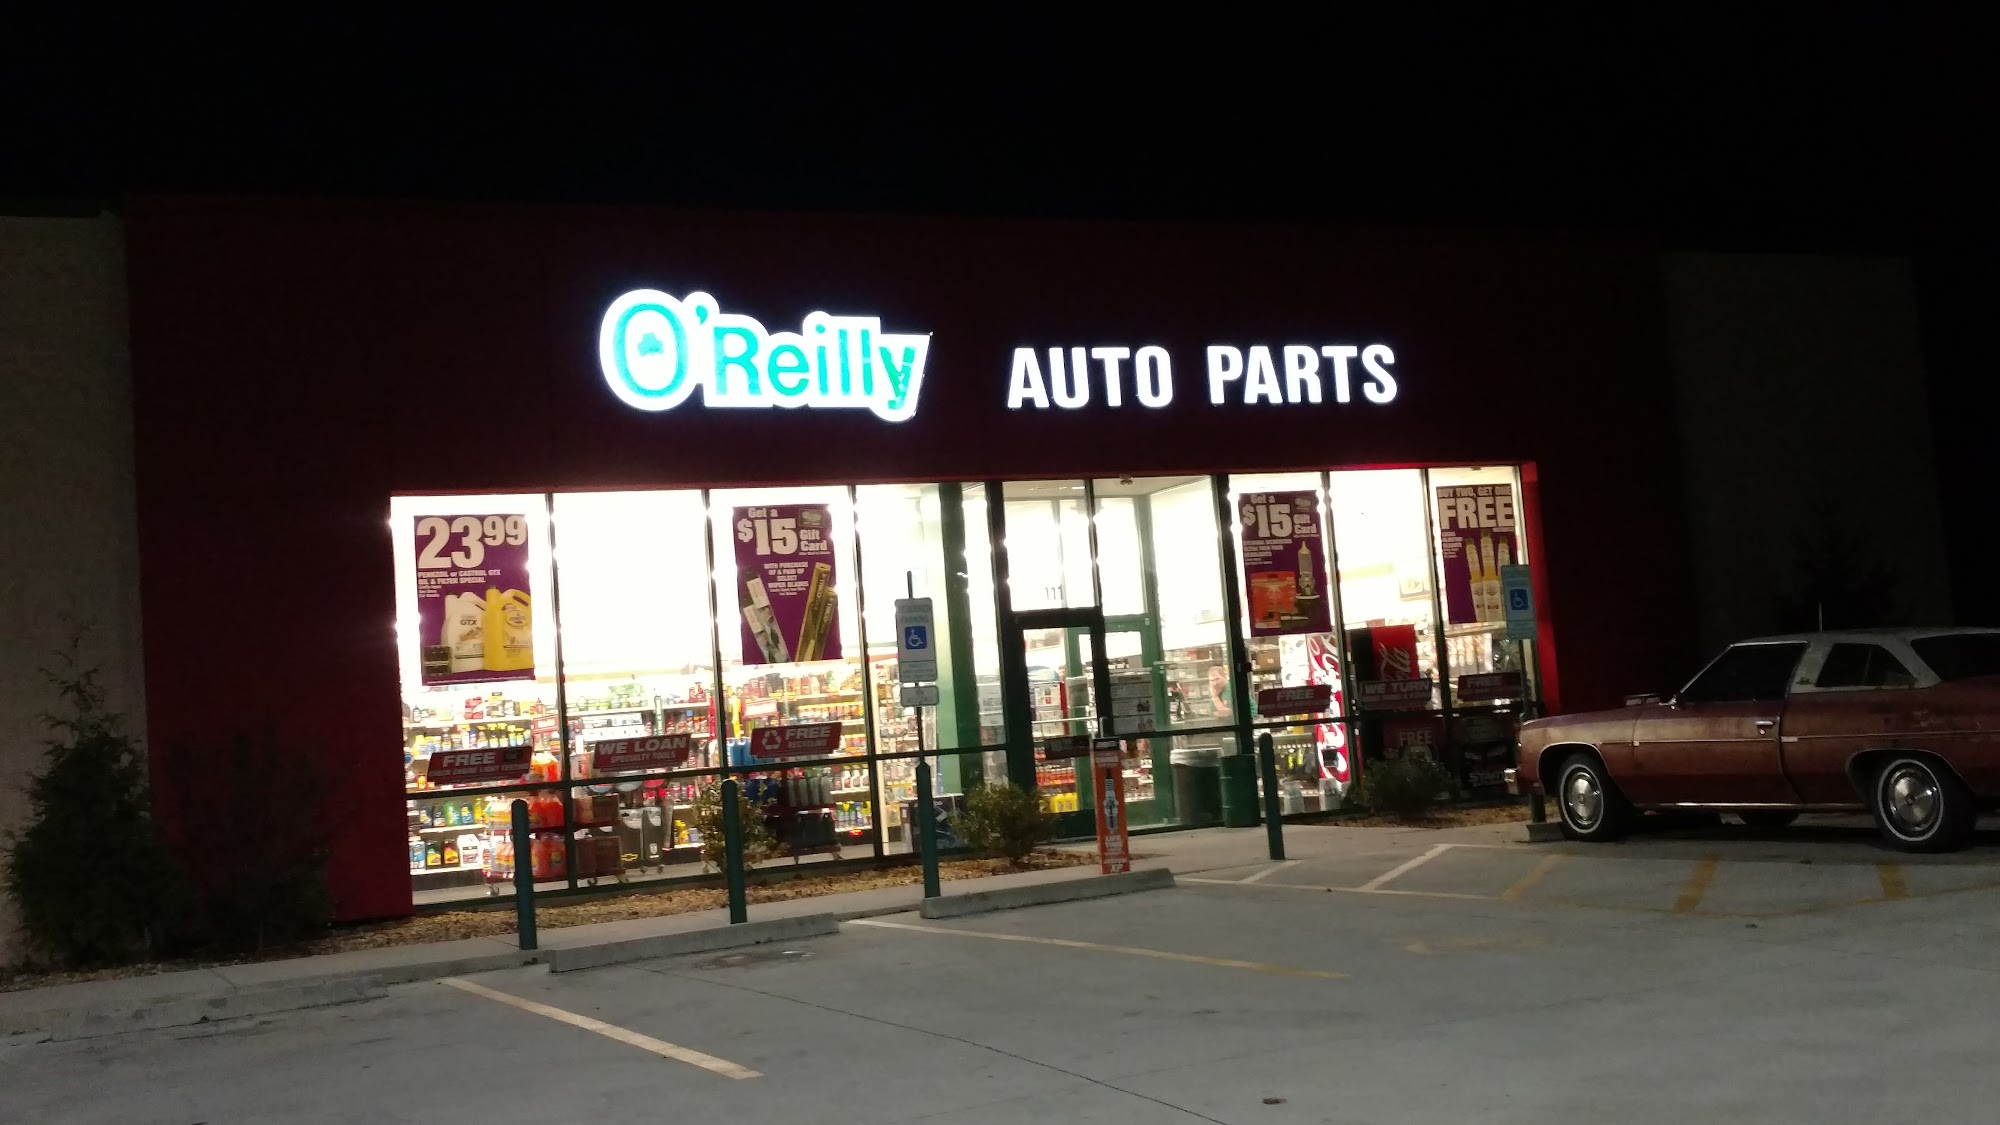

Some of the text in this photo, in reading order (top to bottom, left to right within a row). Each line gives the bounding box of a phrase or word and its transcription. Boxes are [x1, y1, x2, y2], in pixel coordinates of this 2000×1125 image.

[611, 300, 919, 412] O'Reilly
[1007, 343, 1399, 409] AUTO PARTS
[1478, 486, 1493, 496] GET
[748, 508, 779, 518] Get a
[1242, 503, 1293, 538] $15
[1438, 496, 1516, 529] FREE
[737, 518, 798, 555] $15
[800, 528, 820, 541] Gift
[800, 540, 828, 552] Card
[1276, 687, 1316, 702] FREE
[1391, 681, 1430, 693] TURN
[784, 726, 832, 740] FREE
[1400, 730, 1433, 747] FREE
[599, 736, 687, 755] WE LOAN
[442, 751, 497, 768] FREE
